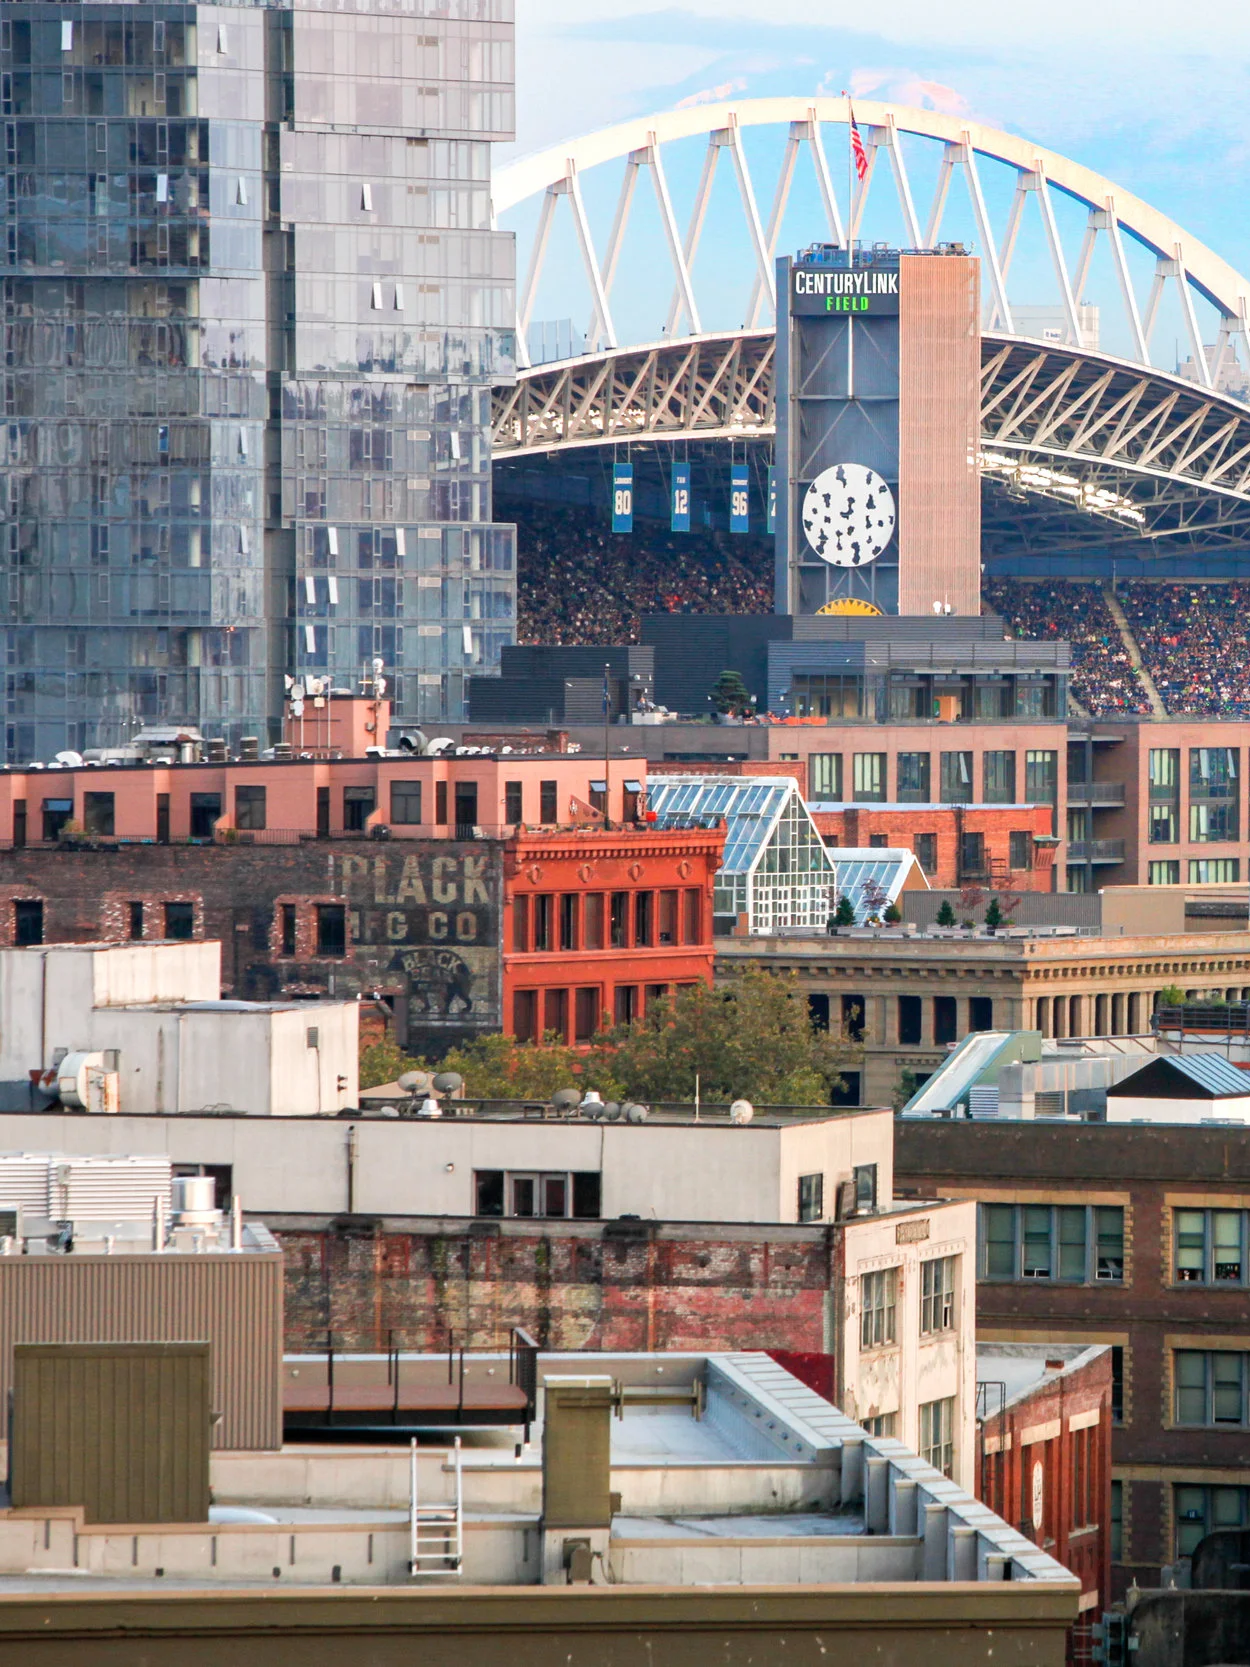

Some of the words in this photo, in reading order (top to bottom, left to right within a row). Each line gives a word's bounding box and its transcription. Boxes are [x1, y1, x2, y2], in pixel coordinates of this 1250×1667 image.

[795, 271, 899, 294] CENTURYLINK
[825, 296, 869, 311] FIELD
[615, 490, 631, 515] 80
[674, 490, 688, 514] 12
[732, 491, 747, 516] 96
[428, 911, 477, 941] CO
